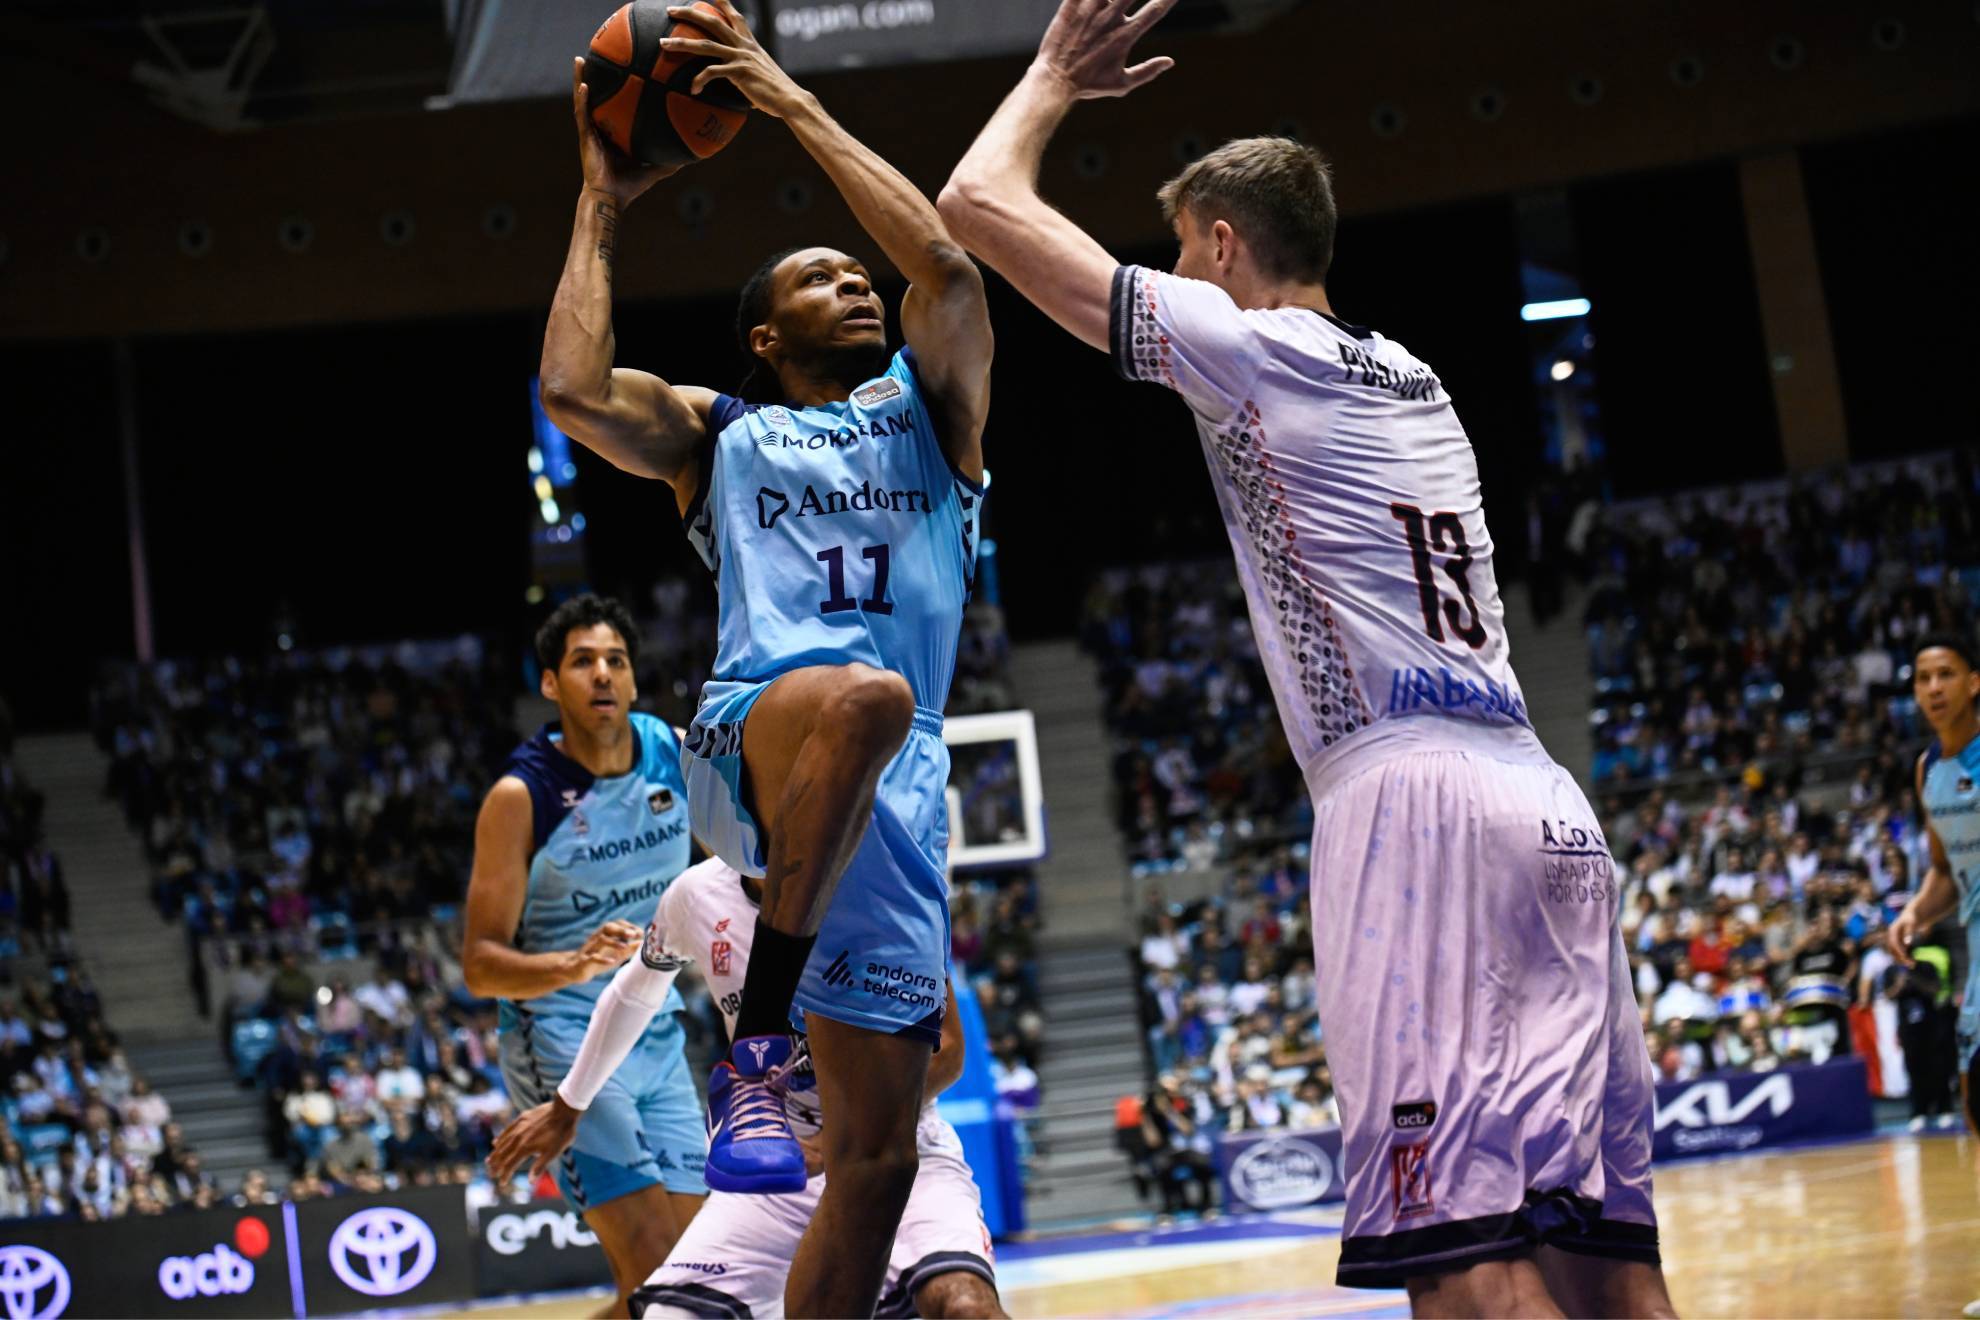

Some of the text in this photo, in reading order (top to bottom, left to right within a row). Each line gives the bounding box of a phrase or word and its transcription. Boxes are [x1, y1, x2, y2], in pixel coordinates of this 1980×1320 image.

[817, 544, 894, 615] 11
[1390, 502, 1488, 650] 13
[863, 978, 935, 1008] telecom
[866, 962, 937, 990] andorra
[1397, 1112, 1428, 1126] acb
[158, 1243, 255, 1300] acb
